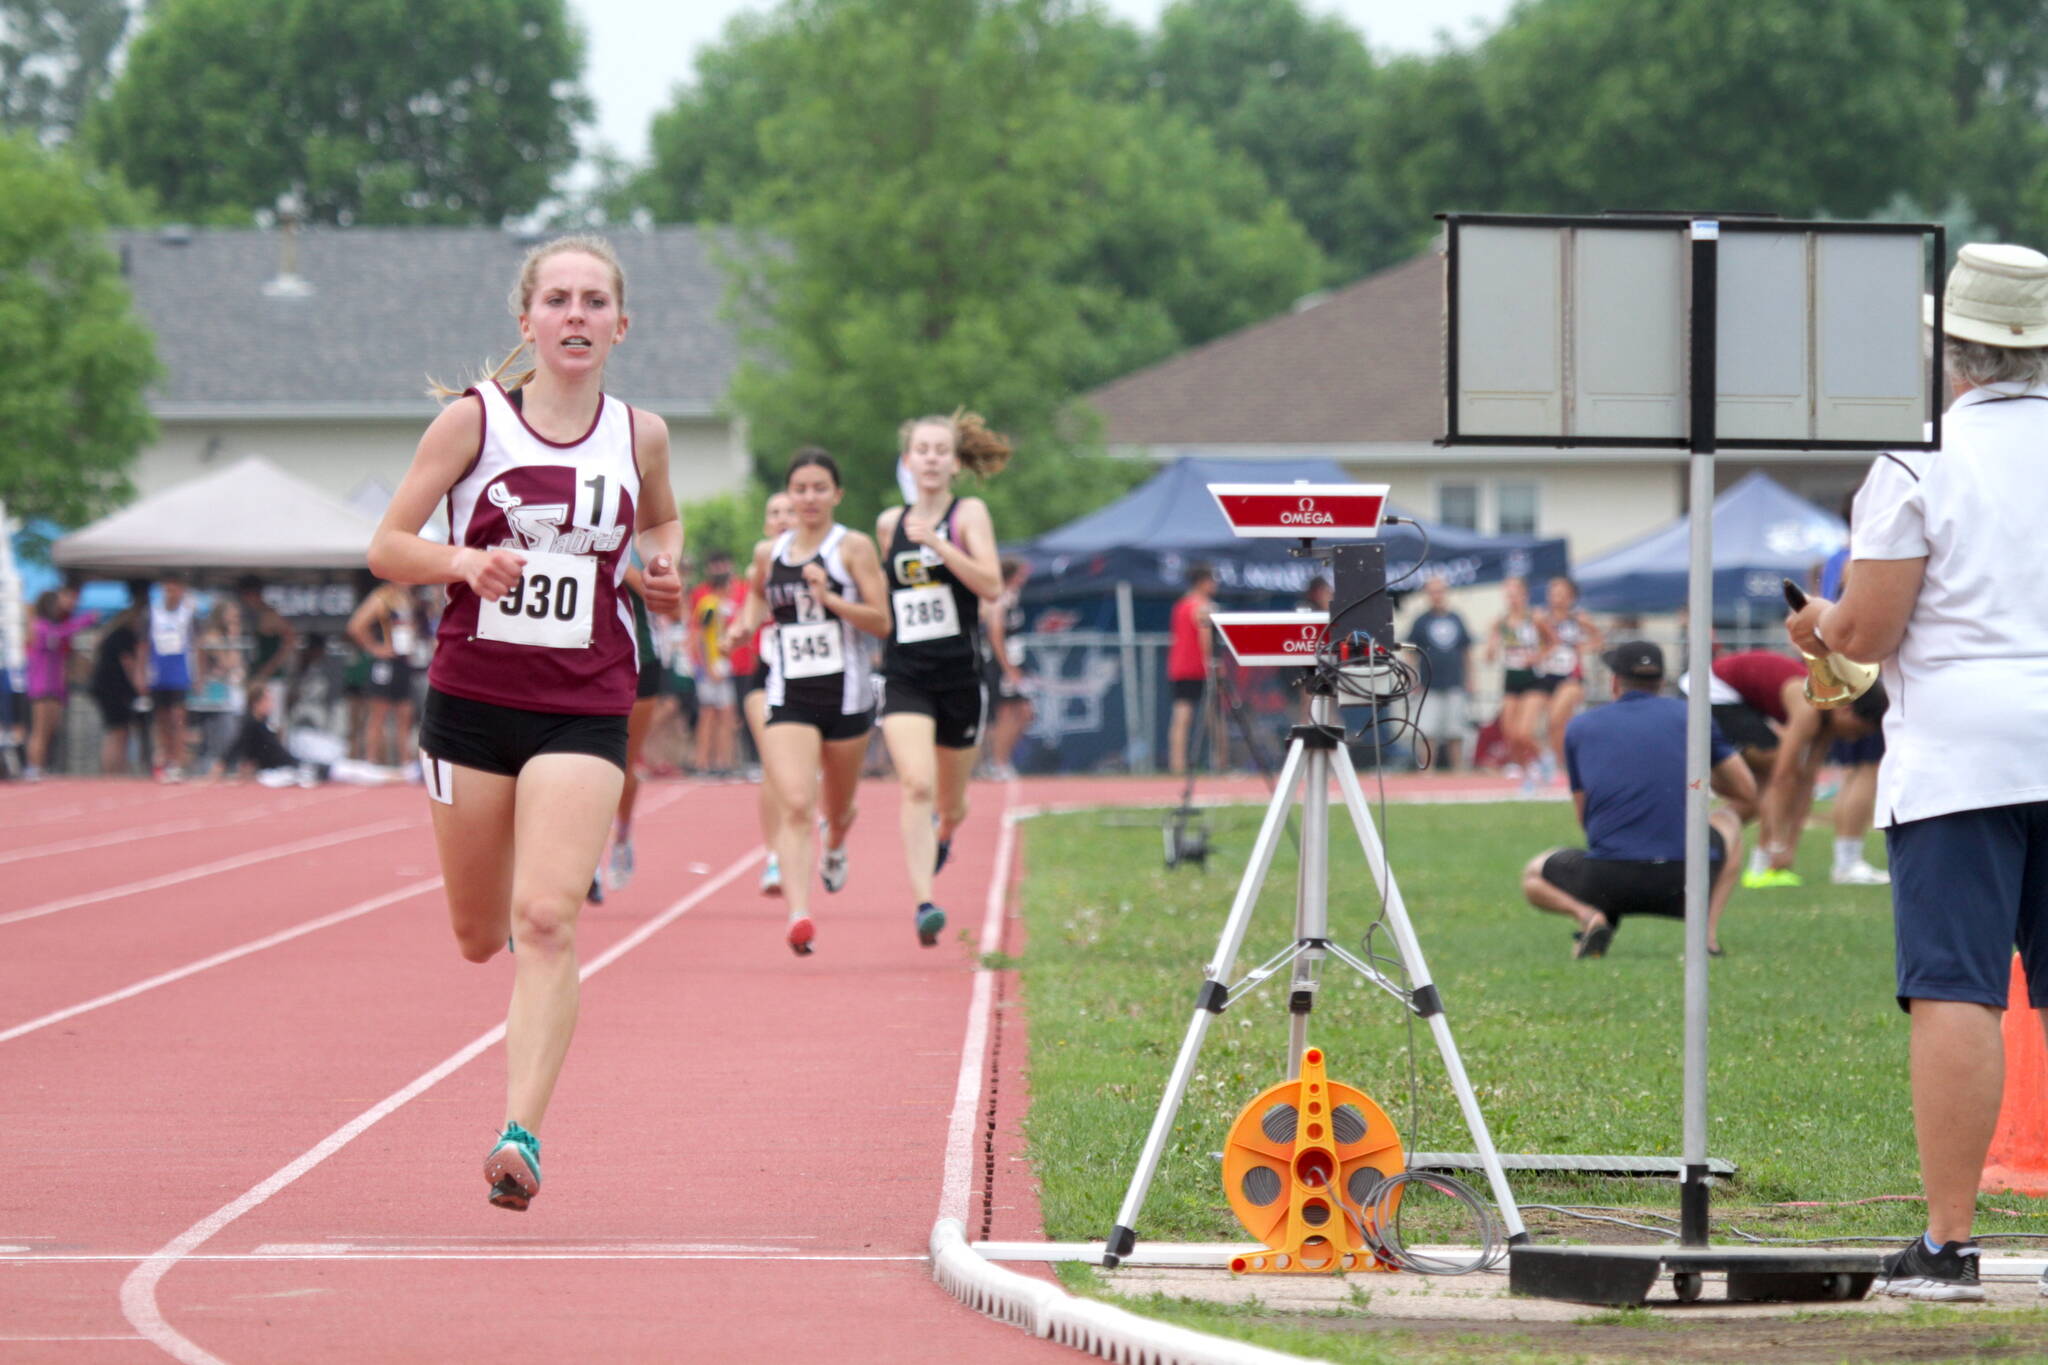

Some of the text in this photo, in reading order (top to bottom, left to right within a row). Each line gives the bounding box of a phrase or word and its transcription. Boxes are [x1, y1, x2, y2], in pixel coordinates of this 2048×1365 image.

[584, 475, 605, 526] 1
[1280, 512, 1334, 524] OMEGA
[500, 574, 578, 621] 930
[801, 594, 817, 620] 2
[904, 600, 945, 627] 286
[791, 634, 831, 662] 545
